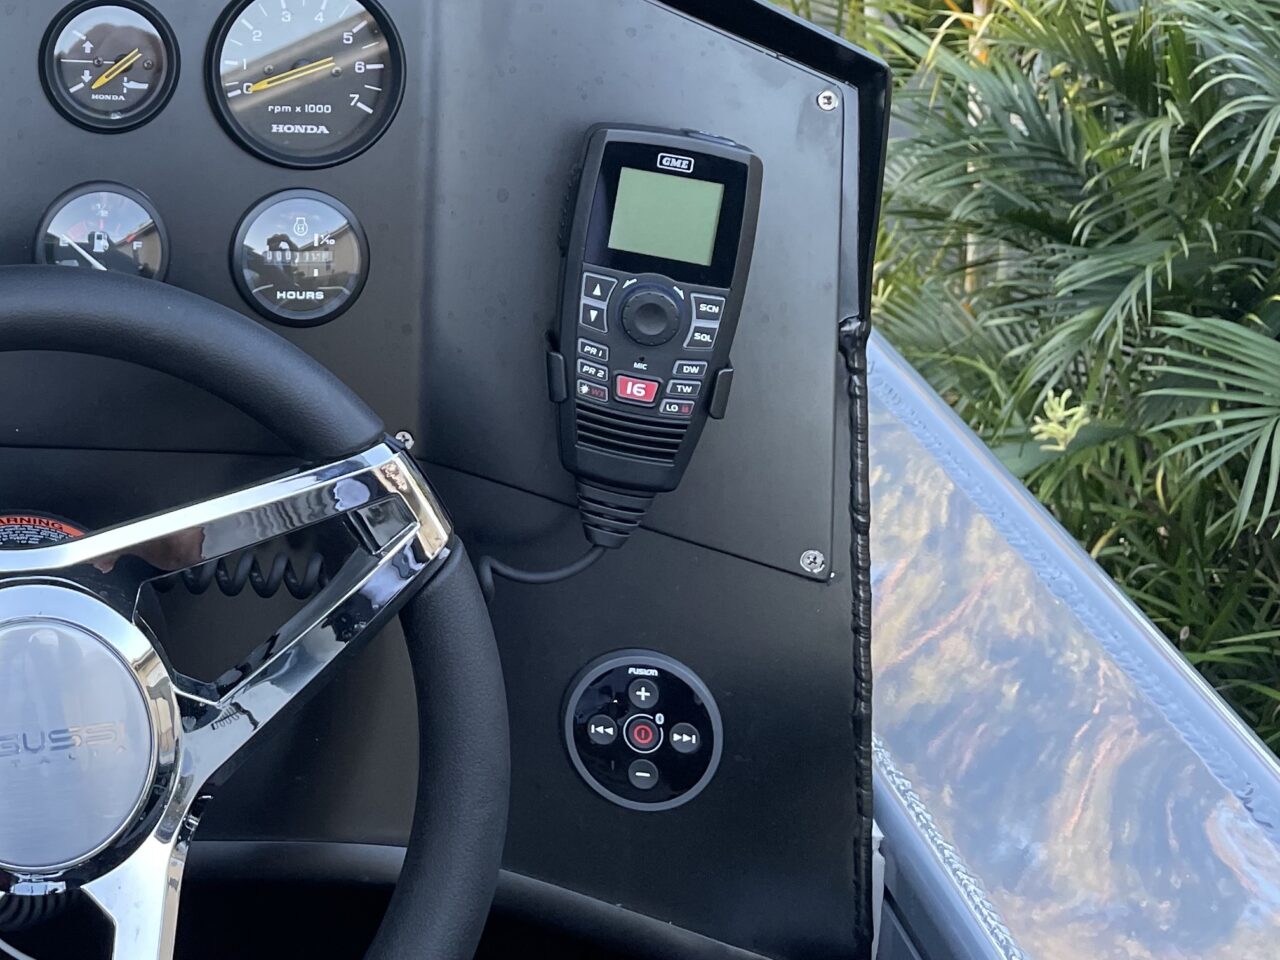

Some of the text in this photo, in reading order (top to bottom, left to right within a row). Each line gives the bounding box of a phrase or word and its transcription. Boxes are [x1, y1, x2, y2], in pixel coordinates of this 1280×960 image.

[281, 11, 291, 22] 3
[314, 12, 324, 22] 4
[252, 30, 262, 41] 2
[343, 32, 353, 44] 5
[355, 62, 365, 73] 6
[91, 93, 125, 101] HONDA
[349, 94, 359, 105] 7
[268, 104, 291, 113] rpm
[305, 104, 332, 113] 1000
[271, 124, 329, 134] HONDA
[661, 156, 689, 170] GME
[132, 241, 142, 250] F
[276, 290, 324, 300] HOURS
[699, 303, 720, 313] SCN
[694, 332, 713, 342] SQL
[584, 345, 598, 355] PR
[633, 361, 648, 370] MIC
[683, 365, 700, 374] DW
[582, 365, 605, 378] PR 2
[626, 381, 646, 397] 16
[676, 384, 693, 393] TW
[666, 403, 679, 412] LO
